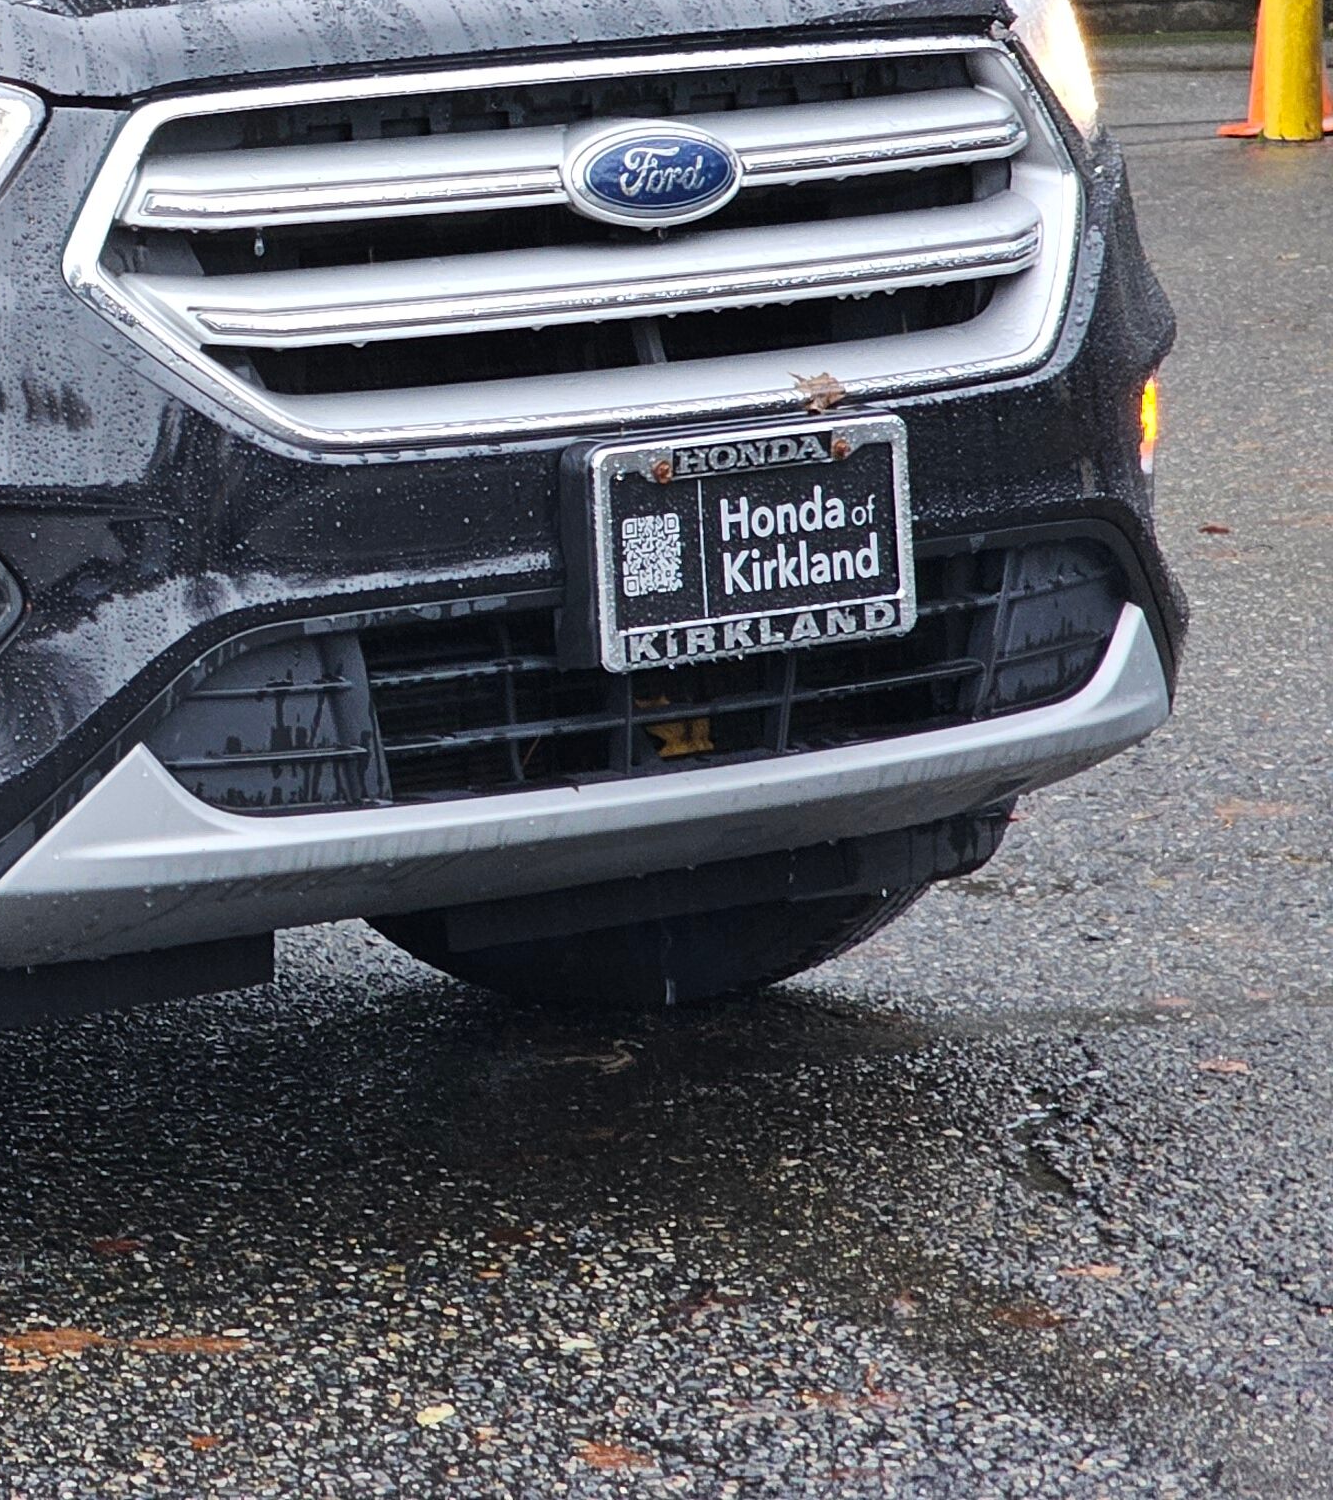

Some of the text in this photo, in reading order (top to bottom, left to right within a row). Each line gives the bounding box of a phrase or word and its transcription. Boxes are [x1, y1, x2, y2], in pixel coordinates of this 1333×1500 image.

[619, 146, 706, 197] Ford
[673, 435, 831, 475] HONDA
[719, 484, 876, 542] Honda of
[721, 532, 881, 596] Kirkland
[628, 600, 896, 664] KIRKLAND
